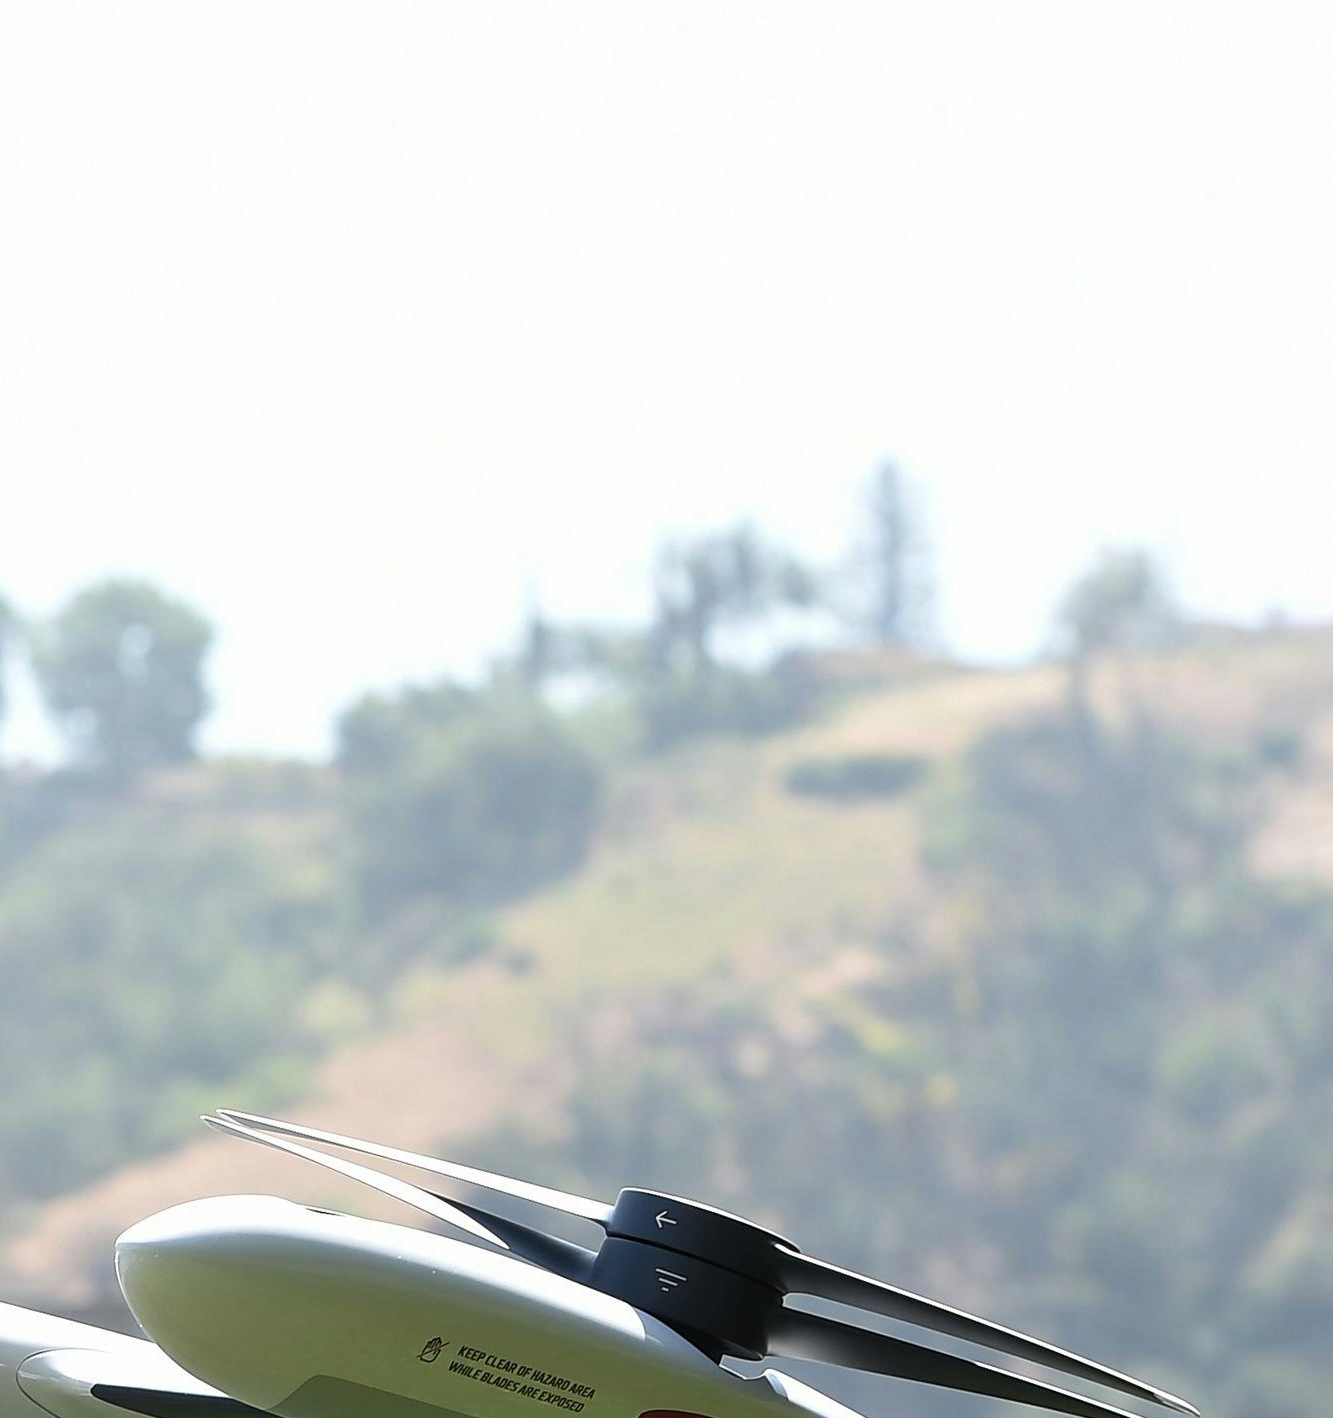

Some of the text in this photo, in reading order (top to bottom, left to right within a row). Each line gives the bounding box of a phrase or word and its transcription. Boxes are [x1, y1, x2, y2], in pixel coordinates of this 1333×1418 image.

[448, 1360, 585, 1413] WHILE BLADES ARE EXPOSED
[457, 1345, 596, 1400] KEEP CLEAR OF HAZARD AREA
